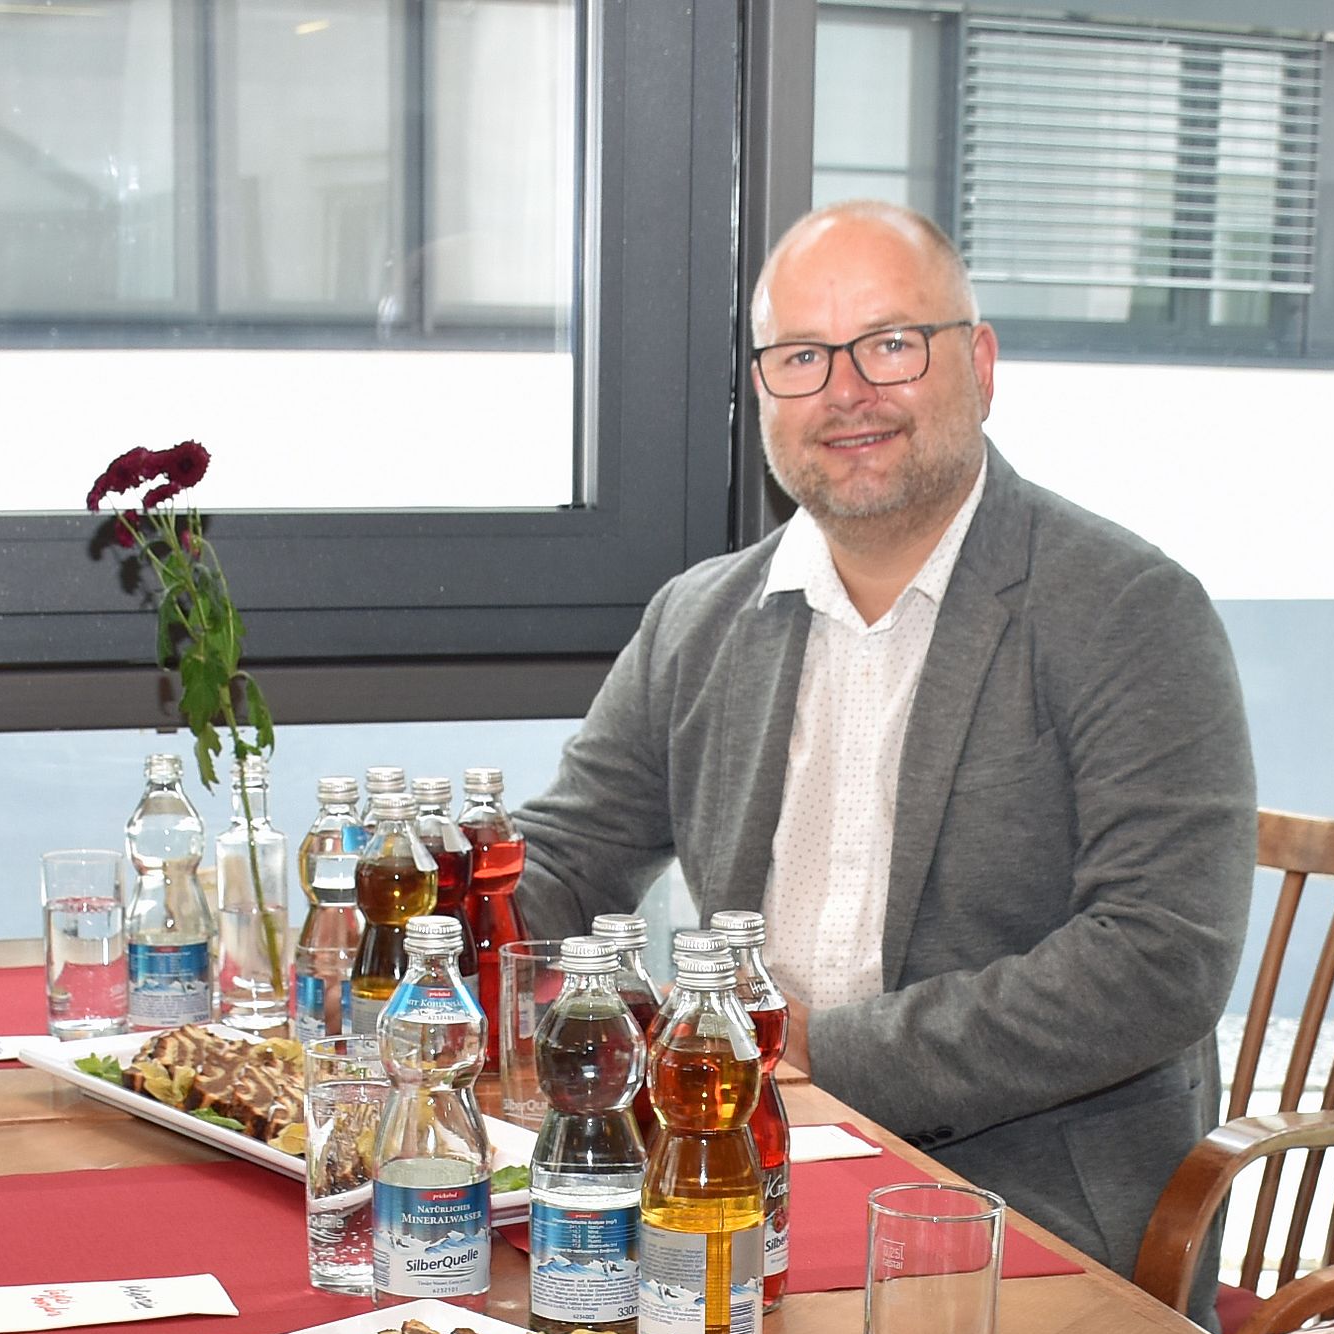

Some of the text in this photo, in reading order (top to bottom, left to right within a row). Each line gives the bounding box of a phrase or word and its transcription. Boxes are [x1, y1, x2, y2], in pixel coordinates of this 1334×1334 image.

[401, 1210, 483, 1226] MINERALWASSER
[405, 1248, 479, 1273] SilberQuelle
[617, 1305, 640, 1318] 330m
